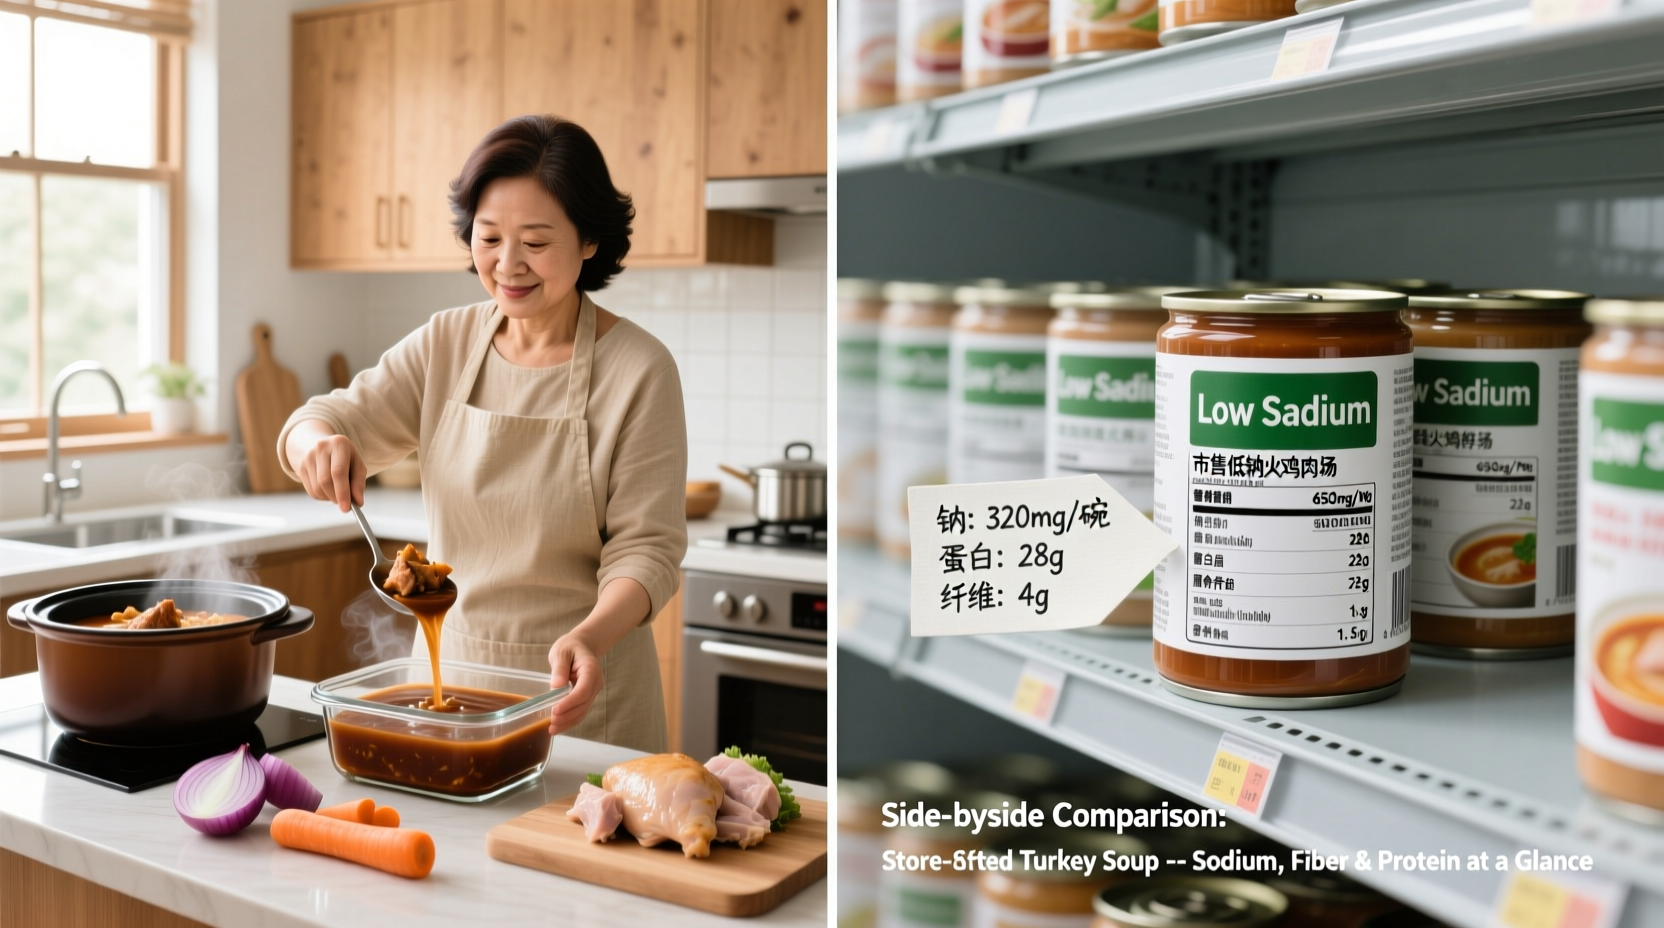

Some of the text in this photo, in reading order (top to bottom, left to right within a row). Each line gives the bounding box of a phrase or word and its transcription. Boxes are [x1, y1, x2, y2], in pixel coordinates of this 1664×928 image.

[1433, 377, 1531, 407] Sadium
[1197, 392, 1371, 427] Low Sadium
[986, 496, 1111, 536] 320mg/碗
[1018, 542, 1064, 576] 28g
[1017, 581, 1049, 615] 4g
